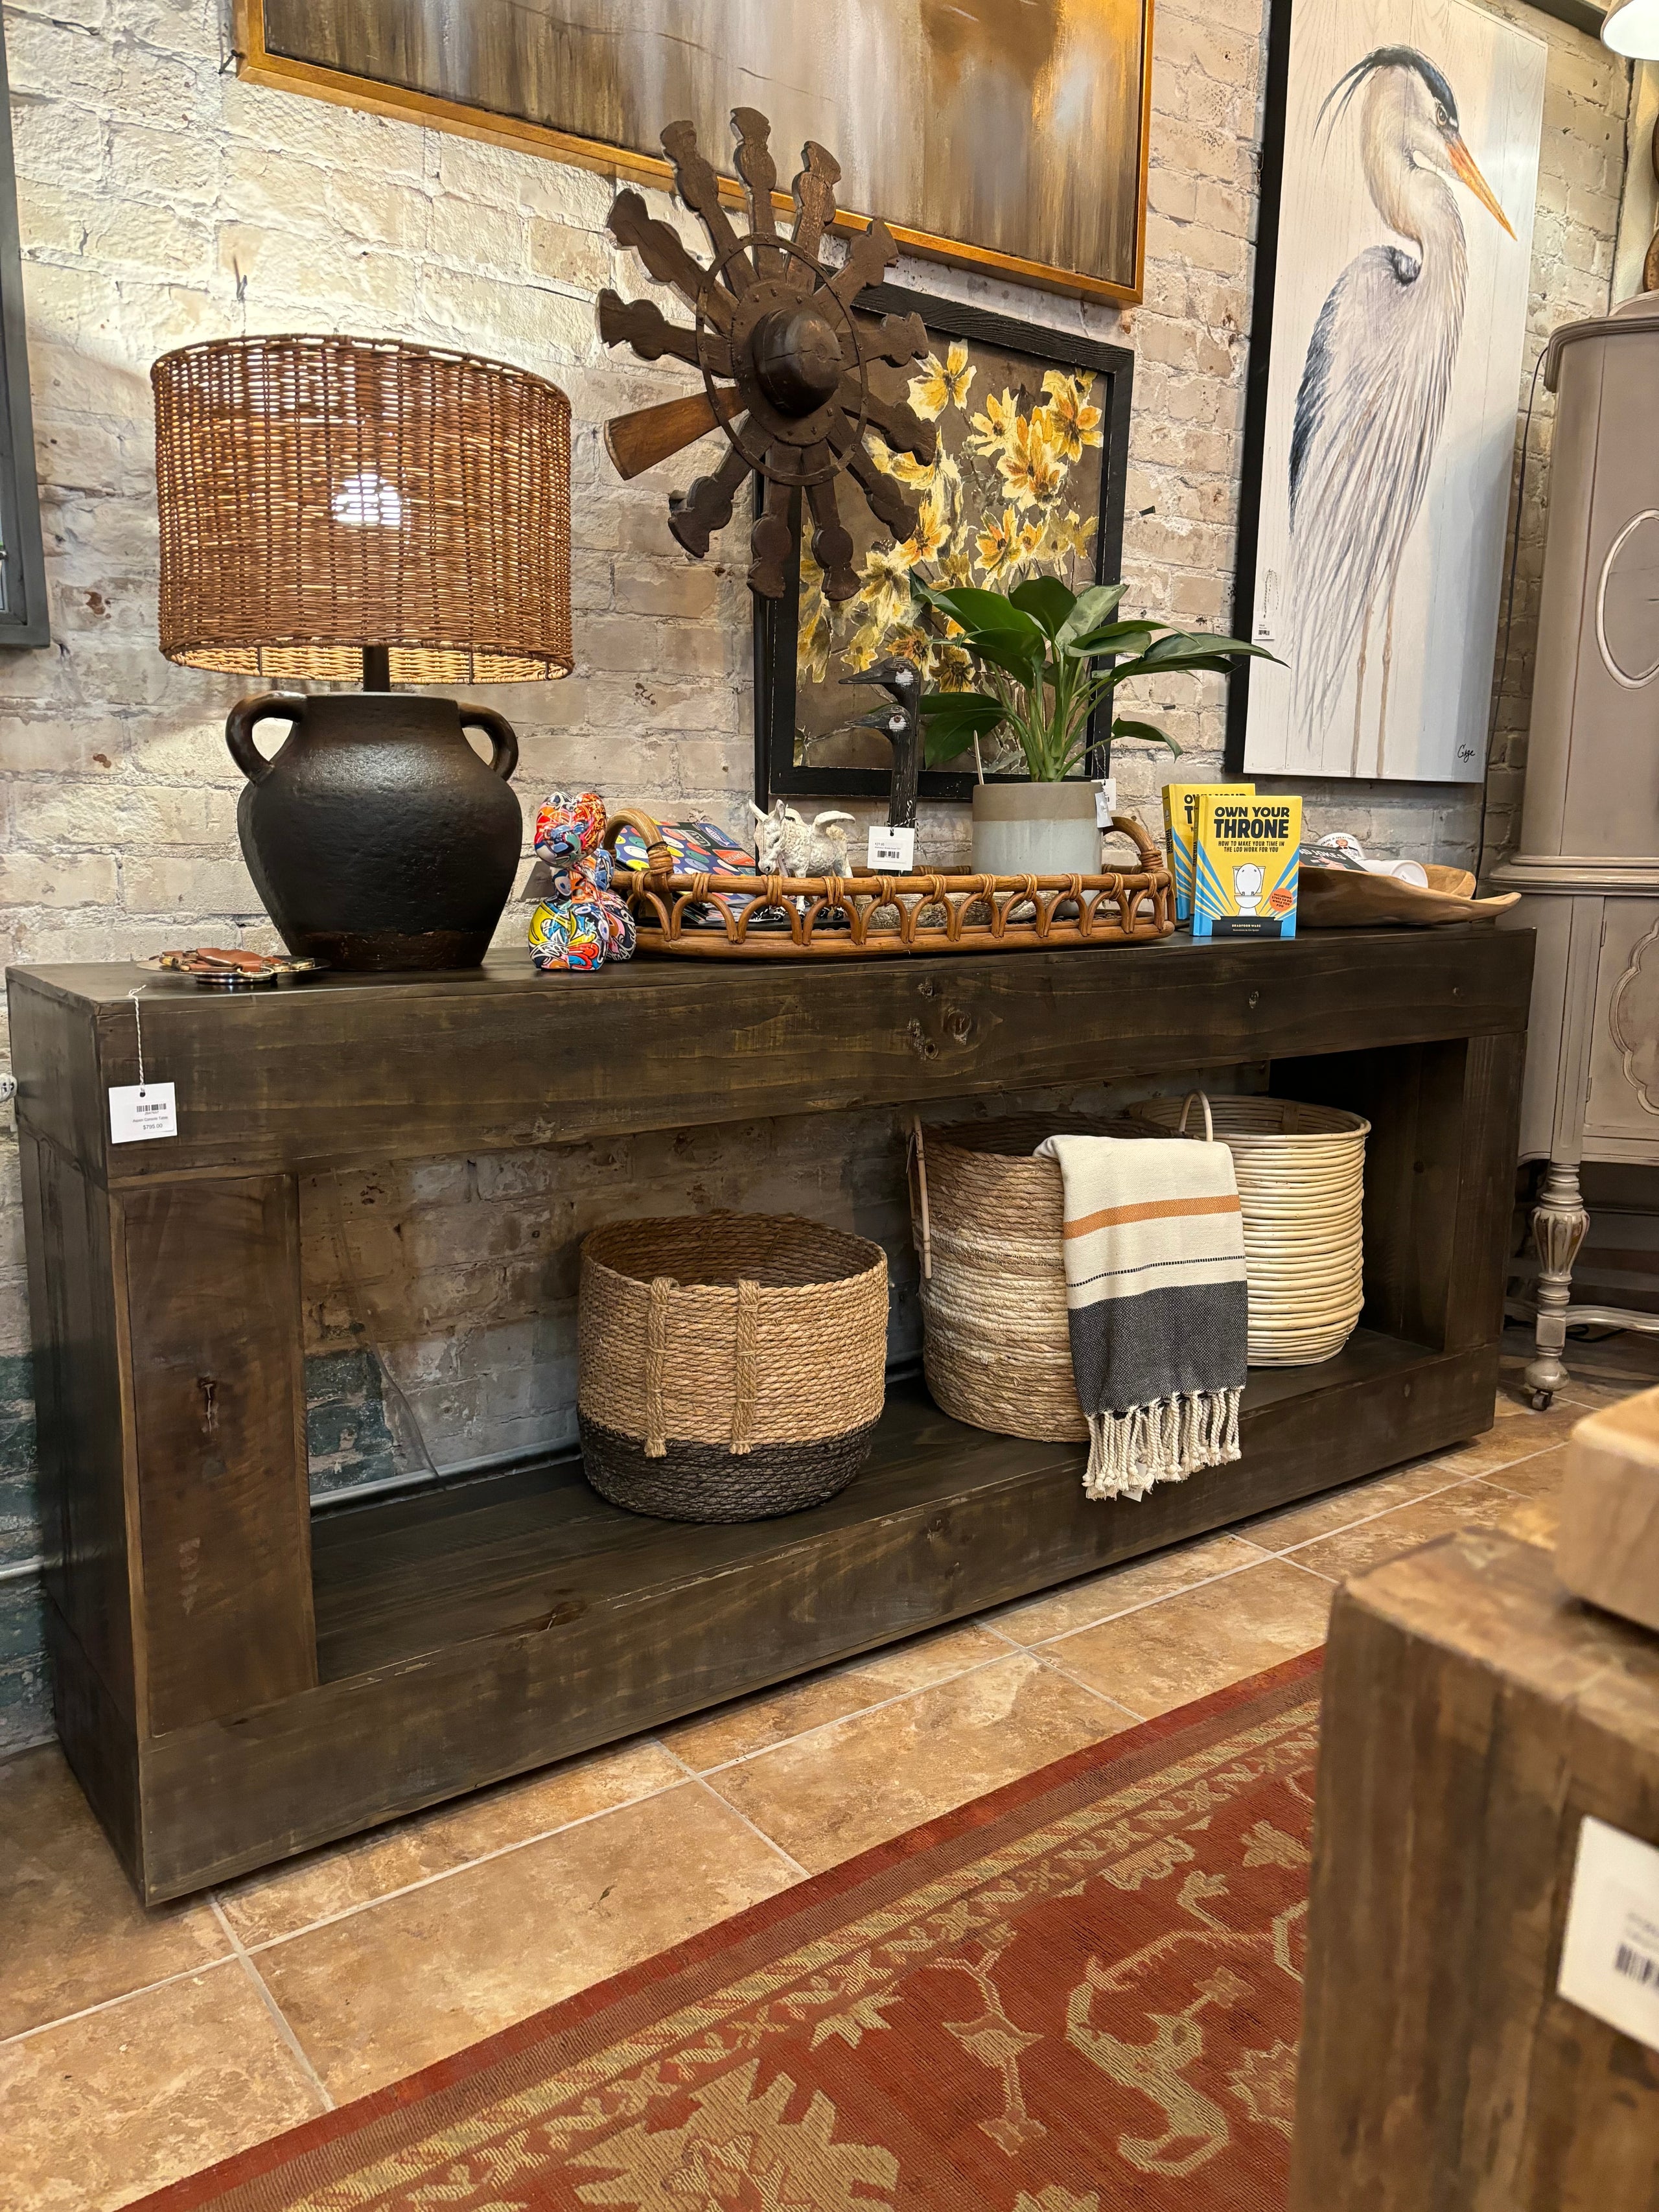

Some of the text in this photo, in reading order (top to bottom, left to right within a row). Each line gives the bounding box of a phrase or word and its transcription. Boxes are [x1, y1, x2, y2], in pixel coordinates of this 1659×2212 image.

[1214, 806, 1290, 817] OWN YOUR
[1213, 819, 1289, 839] THRONE
[1311, 850, 1347, 860] JOKES
